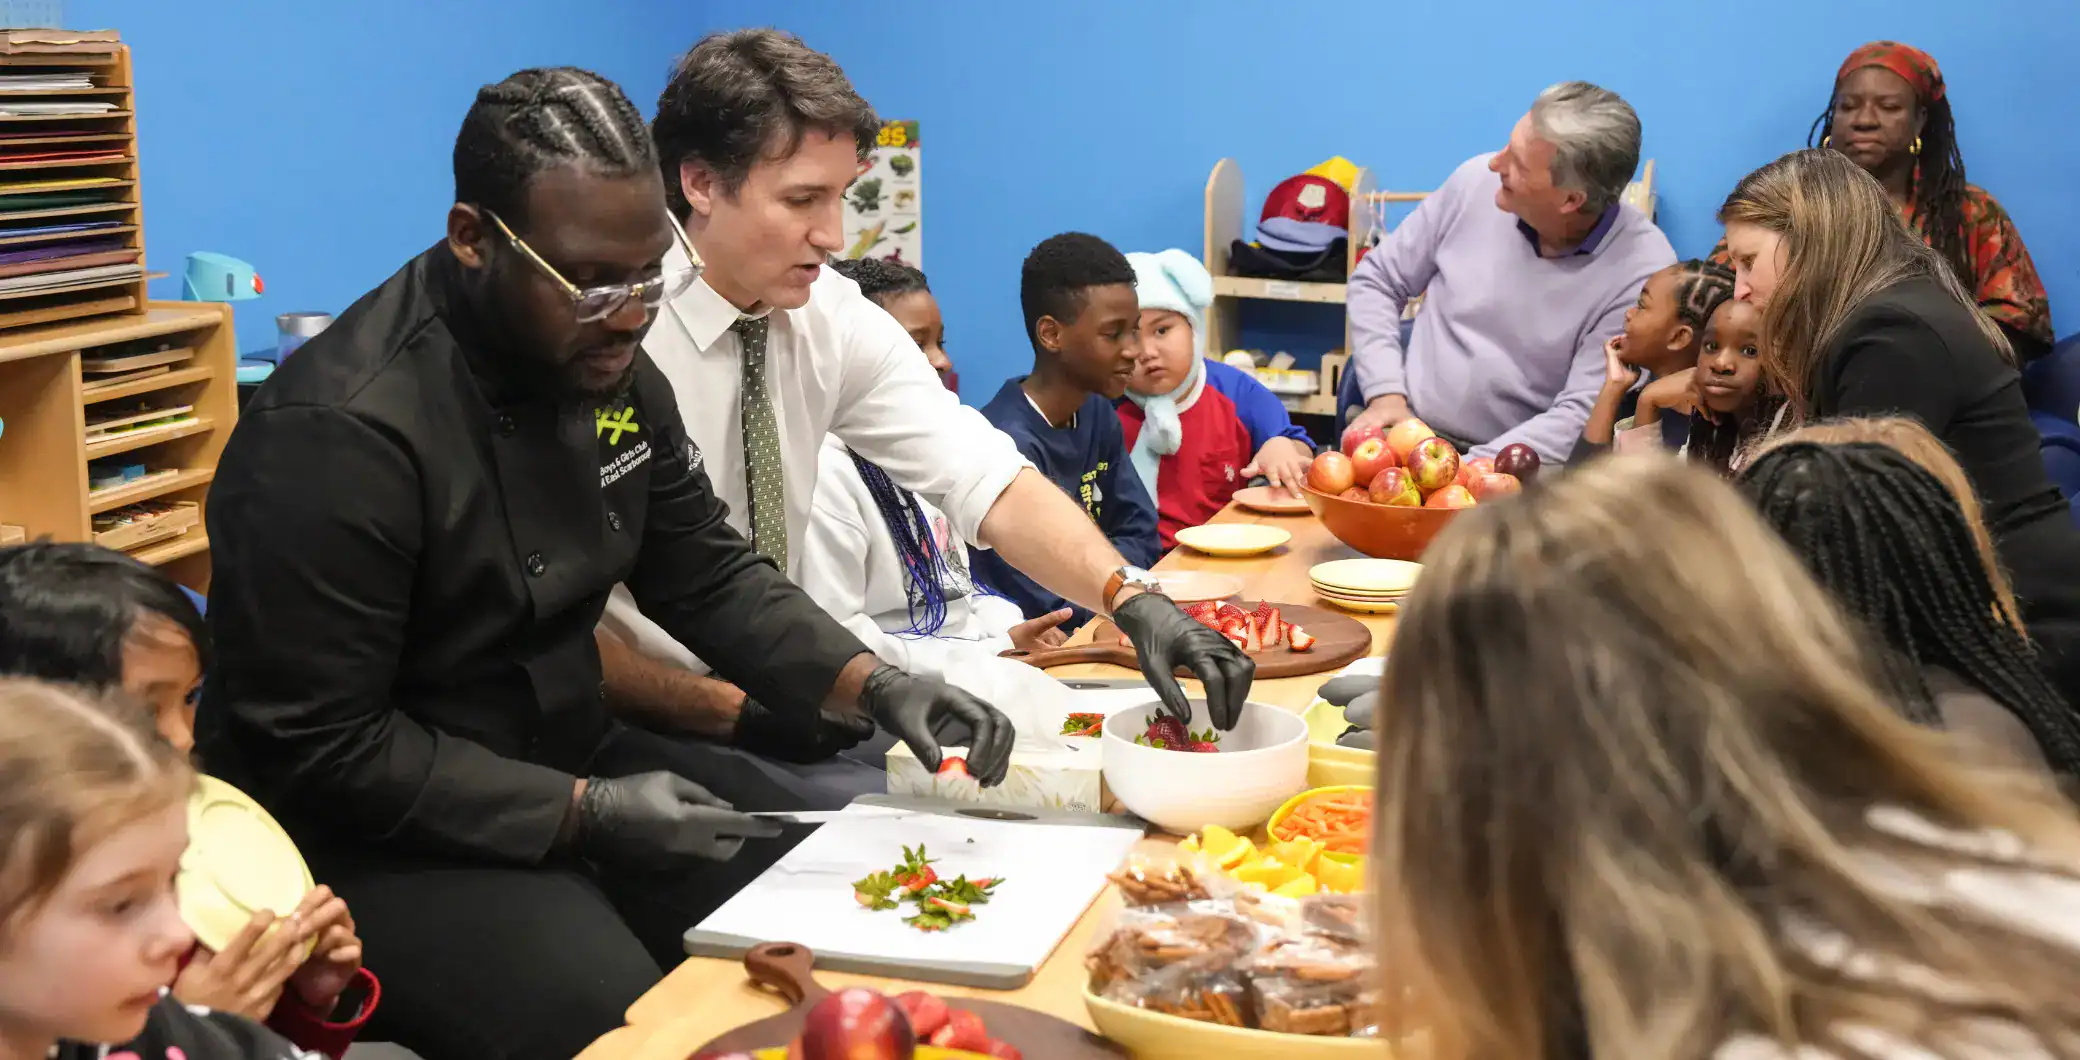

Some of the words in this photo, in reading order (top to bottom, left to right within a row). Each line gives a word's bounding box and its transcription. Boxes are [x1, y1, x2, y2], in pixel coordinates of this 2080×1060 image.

[600, 462, 616, 476] Boys
[620, 449, 636, 463] Girls
[634, 440, 648, 454] Club
[604, 469, 621, 485] East
